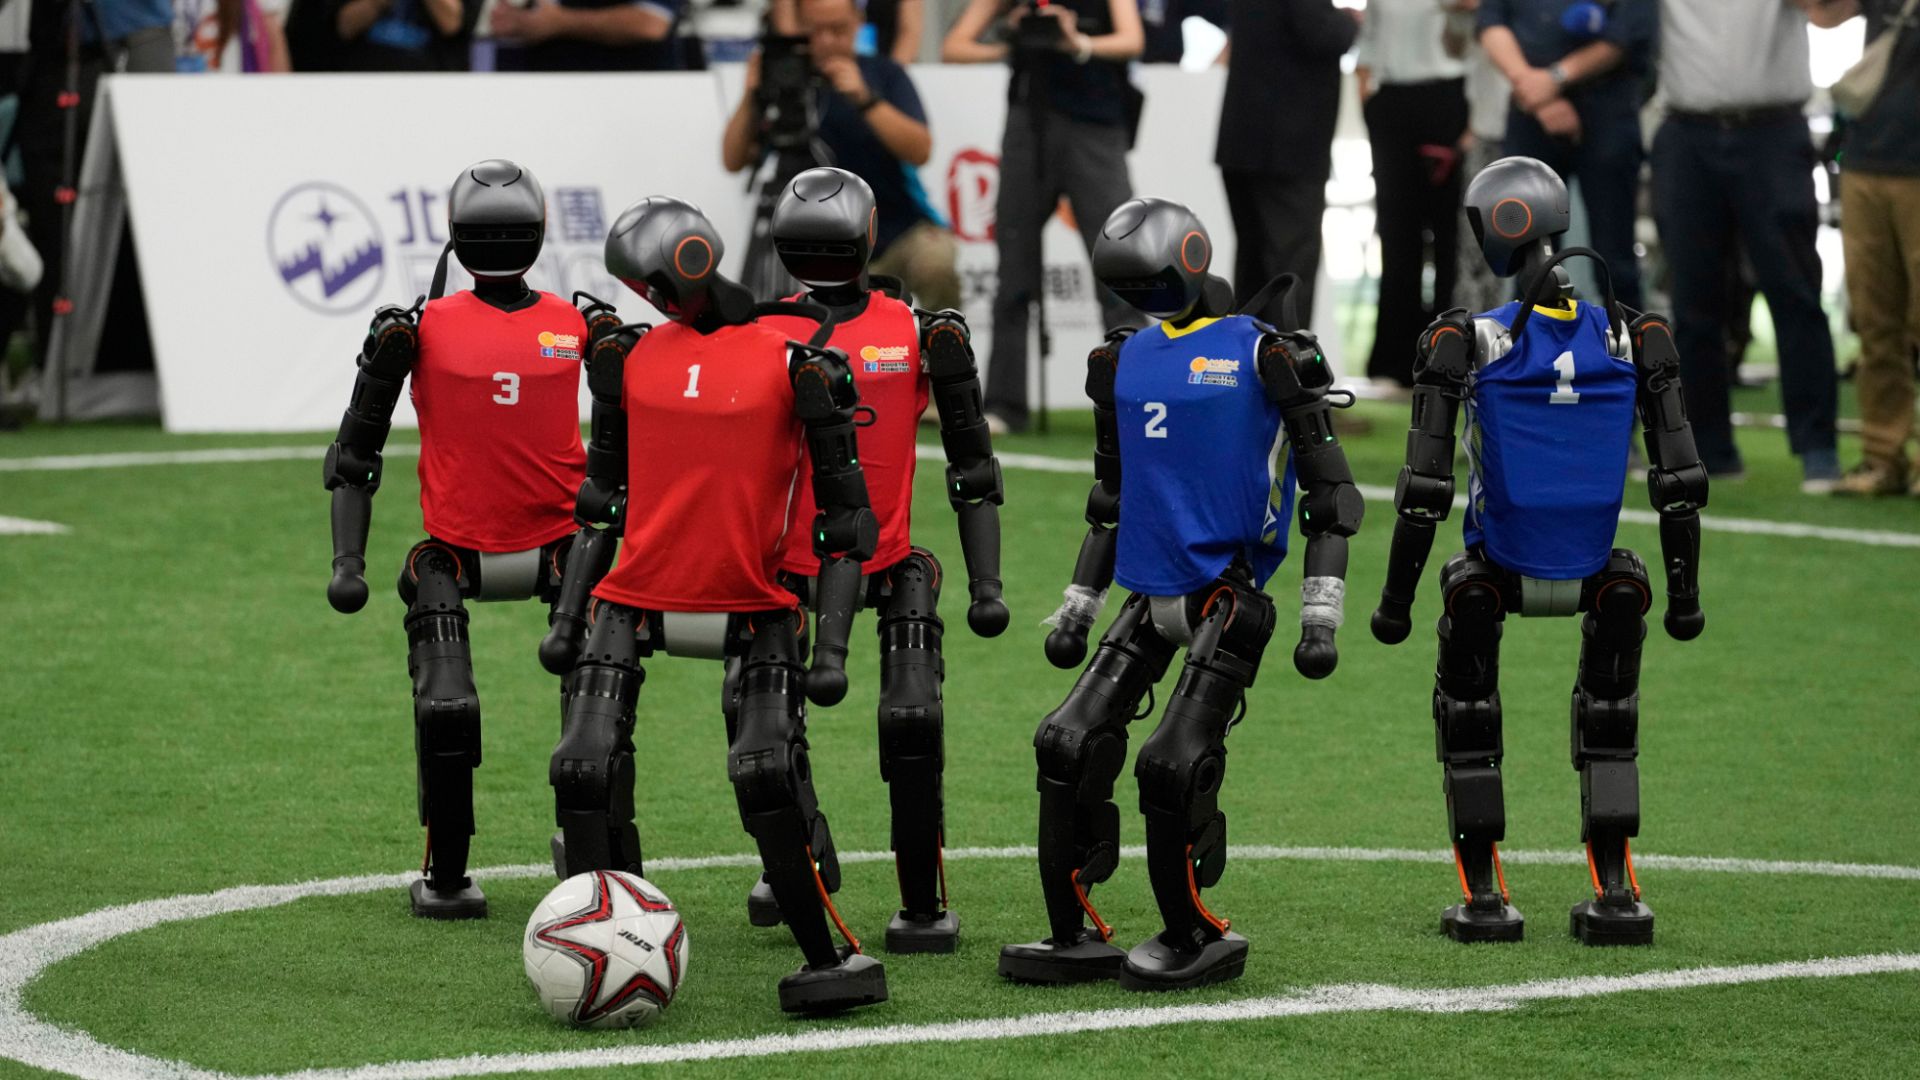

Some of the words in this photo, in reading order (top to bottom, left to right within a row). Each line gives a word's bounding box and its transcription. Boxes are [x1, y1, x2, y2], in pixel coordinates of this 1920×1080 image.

[492, 371, 520, 405] 3
[683, 364, 701, 398] 1
[1549, 351, 1580, 404] 1
[1144, 402, 1167, 438] 2
